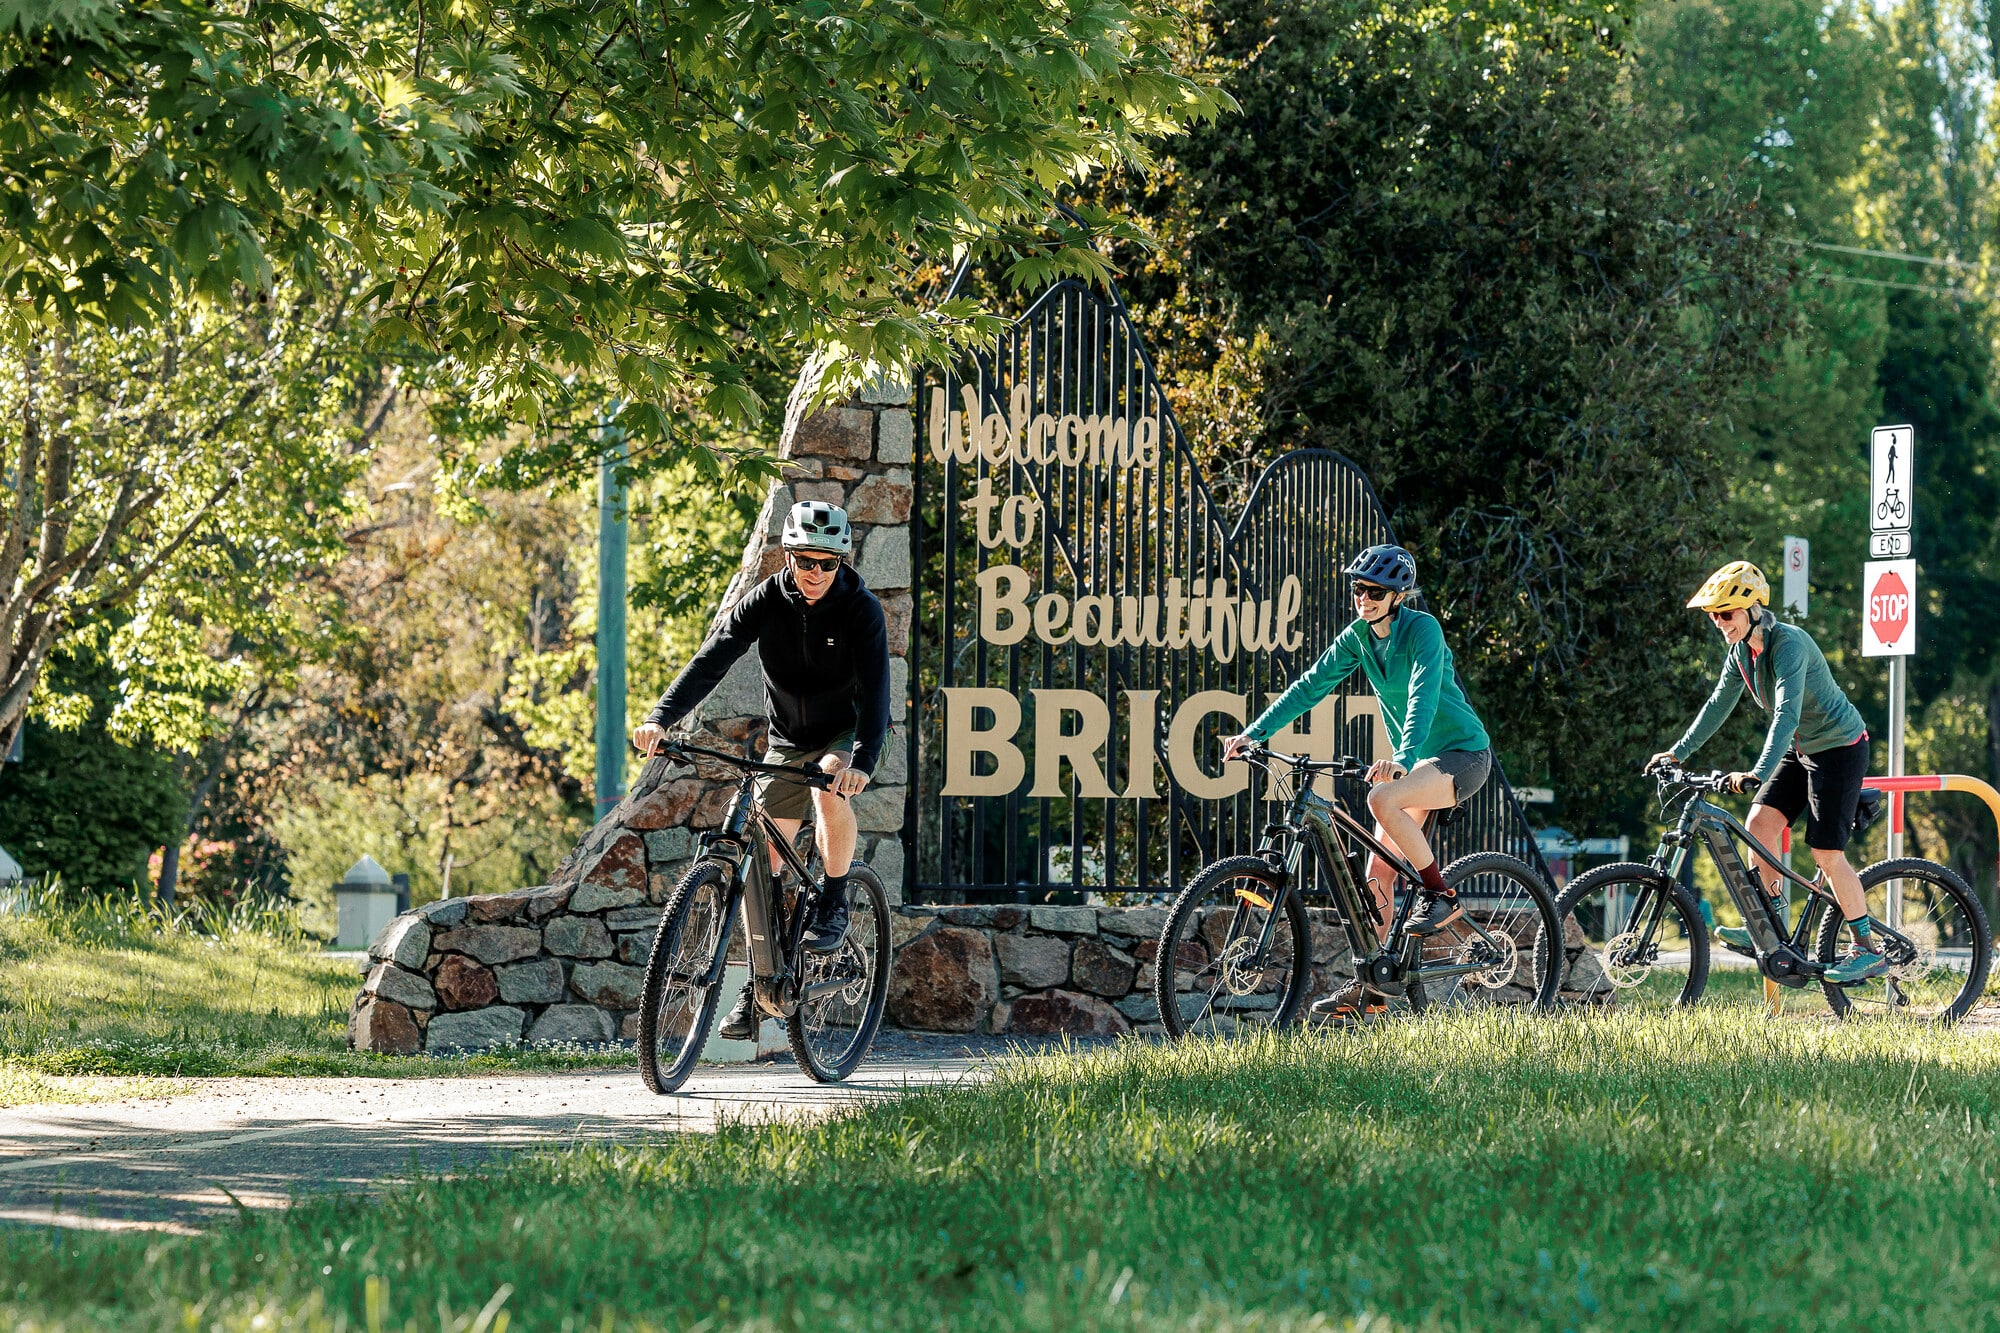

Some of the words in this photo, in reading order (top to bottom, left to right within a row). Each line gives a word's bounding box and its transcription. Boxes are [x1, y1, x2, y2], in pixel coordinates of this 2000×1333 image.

[929, 383, 1160, 468] Welcome
[967, 478, 1043, 548] to
[1880, 538, 1902, 551] END
[975, 565, 1303, 664] Beautiful
[1871, 593, 1908, 623] STOP
[1718, 836, 1777, 937] TREK
